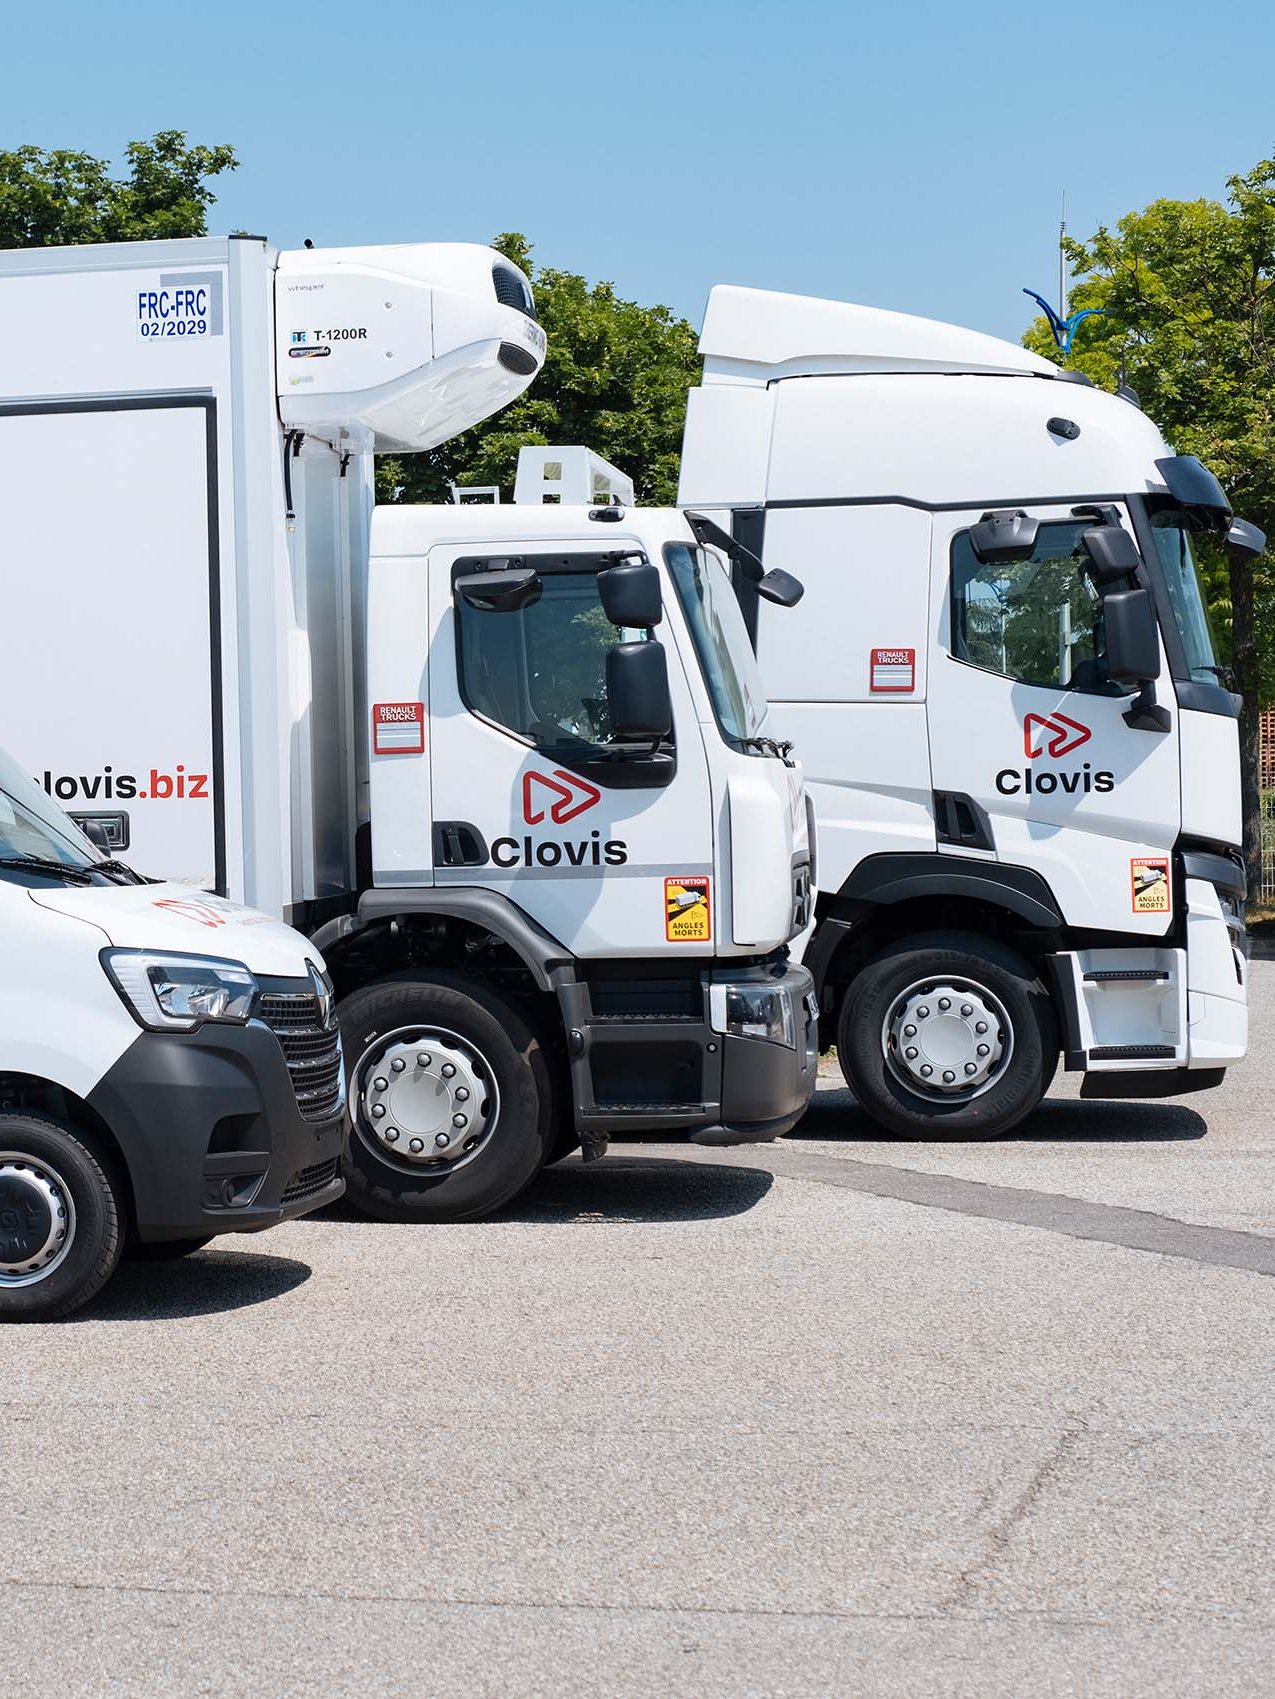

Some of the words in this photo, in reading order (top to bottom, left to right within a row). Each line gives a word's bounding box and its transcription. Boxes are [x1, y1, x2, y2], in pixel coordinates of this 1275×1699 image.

[138, 289, 206, 319] FRC-FRC
[141, 320, 207, 336] 02/2029
[314, 328, 367, 341] T-1200R
[380, 706, 416, 714] RENAULT
[381, 713, 416, 721] TRUCKS
[33, 765, 209, 800] lovis.biz
[995, 763, 1115, 795] Clovis
[490, 830, 628, 868] Clovis
